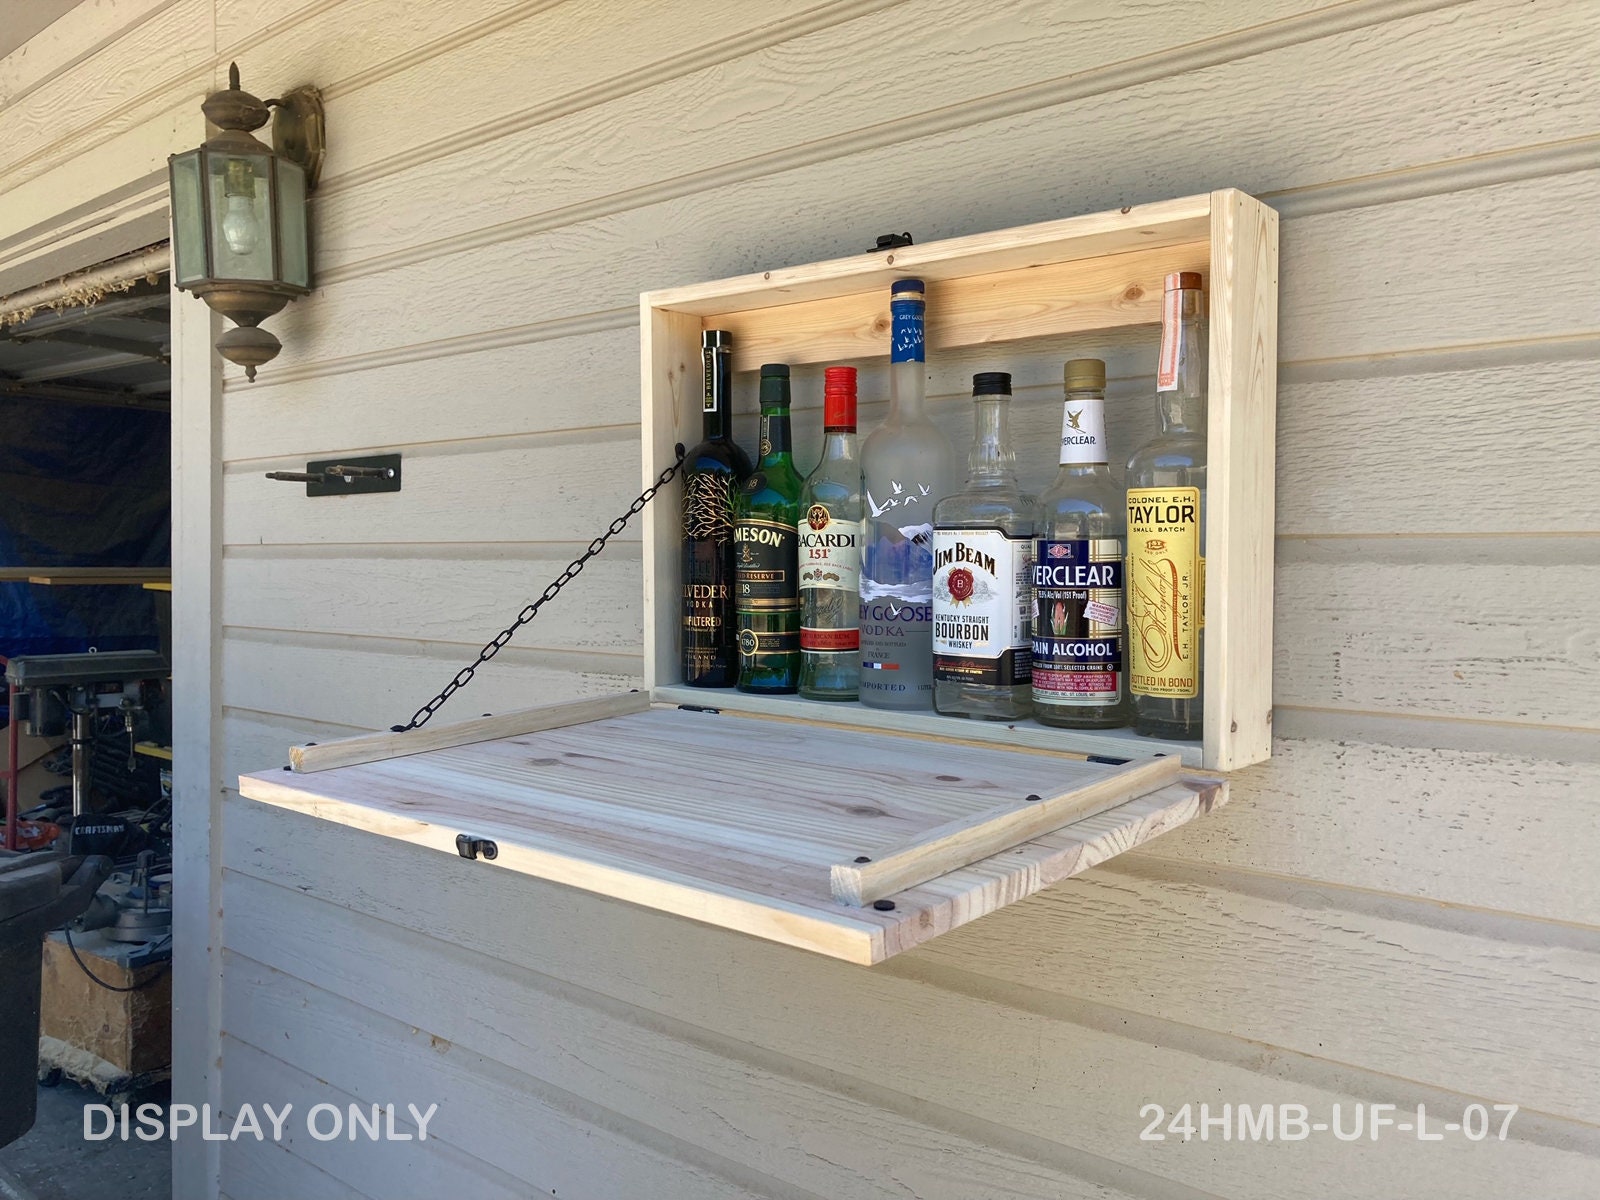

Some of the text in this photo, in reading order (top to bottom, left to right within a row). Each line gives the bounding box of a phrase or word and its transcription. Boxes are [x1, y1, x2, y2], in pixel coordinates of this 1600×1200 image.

[1128, 496, 1168, 504] COLONEL
[1128, 505, 1195, 524] TAYLOR
[933, 542, 996, 577] JIM BEAM
[742, 583, 751, 594] 18
[957, 579, 964, 588] B
[872, 605, 933, 622] GOOSE
[935, 613, 989, 624] KENTUCKY STRAIGHT
[861, 624, 905, 637] VODKA
[935, 622, 989, 641] BOURBON
[741, 637, 755, 647] 1780
[948, 640, 973, 649] WHISKEY
[1052, 643, 1113, 657] ALCOHOL
[1131, 674, 1193, 688] BOTTLED IN BOND
[75, 824, 125, 835] CRAFTSMAN
